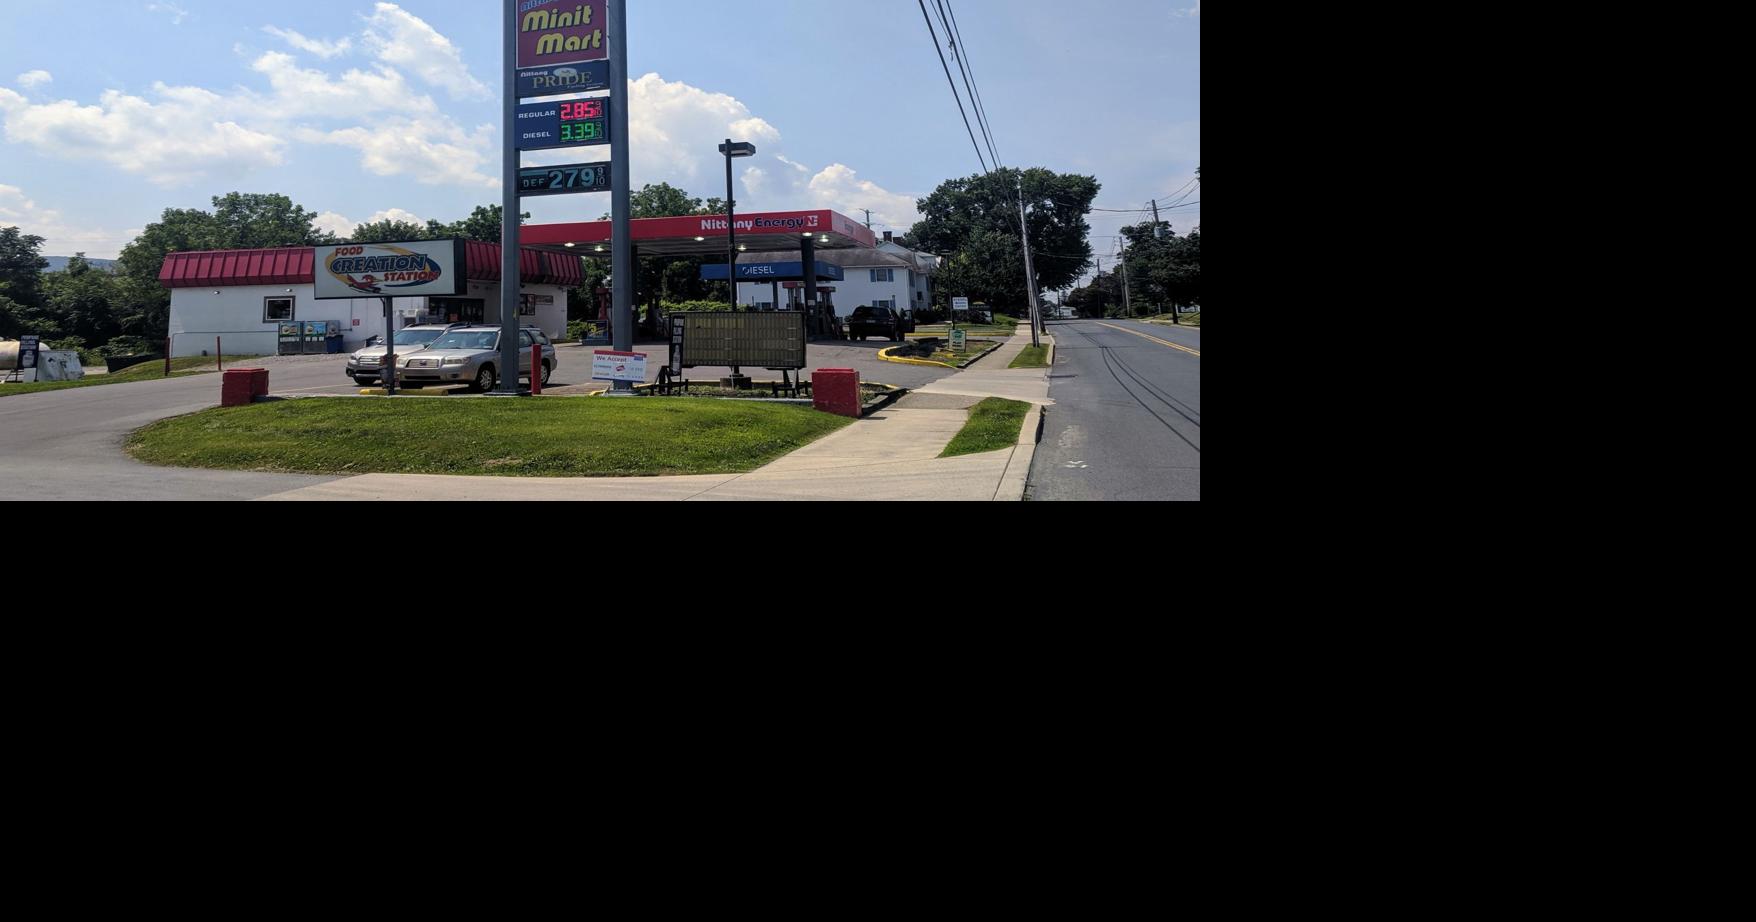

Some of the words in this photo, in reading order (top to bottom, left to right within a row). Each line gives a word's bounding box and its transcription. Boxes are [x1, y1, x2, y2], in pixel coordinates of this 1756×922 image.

[522, 5, 592, 32] Minit
[536, 29, 601, 54] Mart
[533, 71, 592, 88] PRIDE
[518, 110, 556, 119] REGULAR
[560, 101, 594, 119] 2.85
[522, 131, 551, 139] DIESEL
[561, 122, 594, 140] 3.39
[523, 178, 544, 187] DEF
[548, 168, 595, 189] 279
[755, 217, 803, 229] Energy
[335, 246, 363, 256] FOOD
[331, 254, 427, 274] CREATION
[742, 265, 774, 275] DIESEL
[384, 271, 439, 281] STATION
